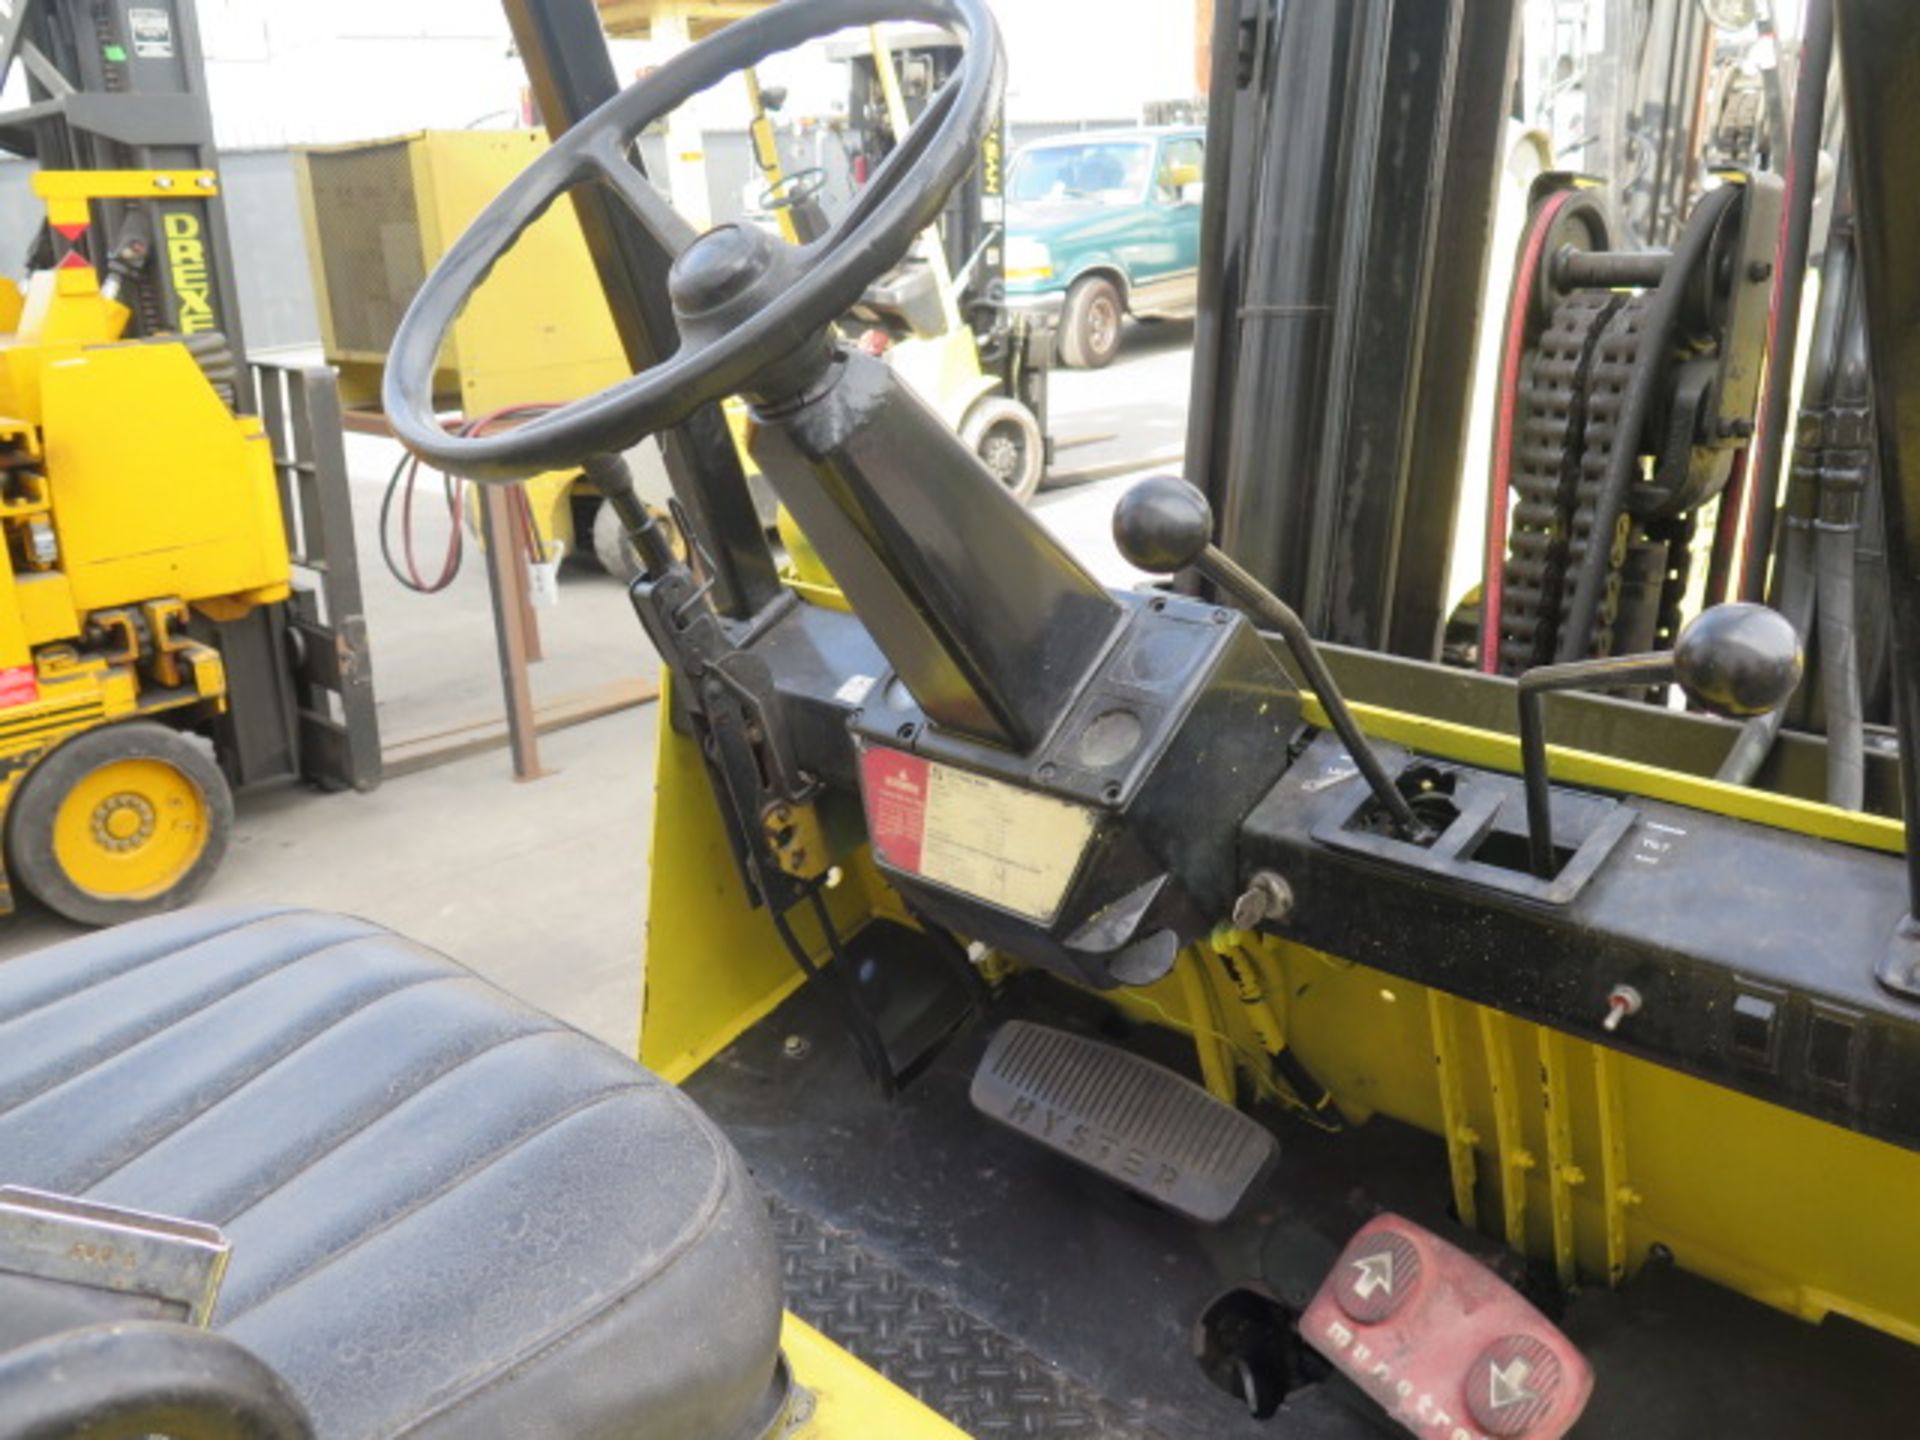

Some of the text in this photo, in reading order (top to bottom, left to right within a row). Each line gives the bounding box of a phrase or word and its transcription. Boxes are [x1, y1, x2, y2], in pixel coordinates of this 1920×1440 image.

[163, 211, 215, 336] DREXE
[1008, 1095, 1180, 1196] HYSTER
[1326, 1321, 1490, 1440] monotro
